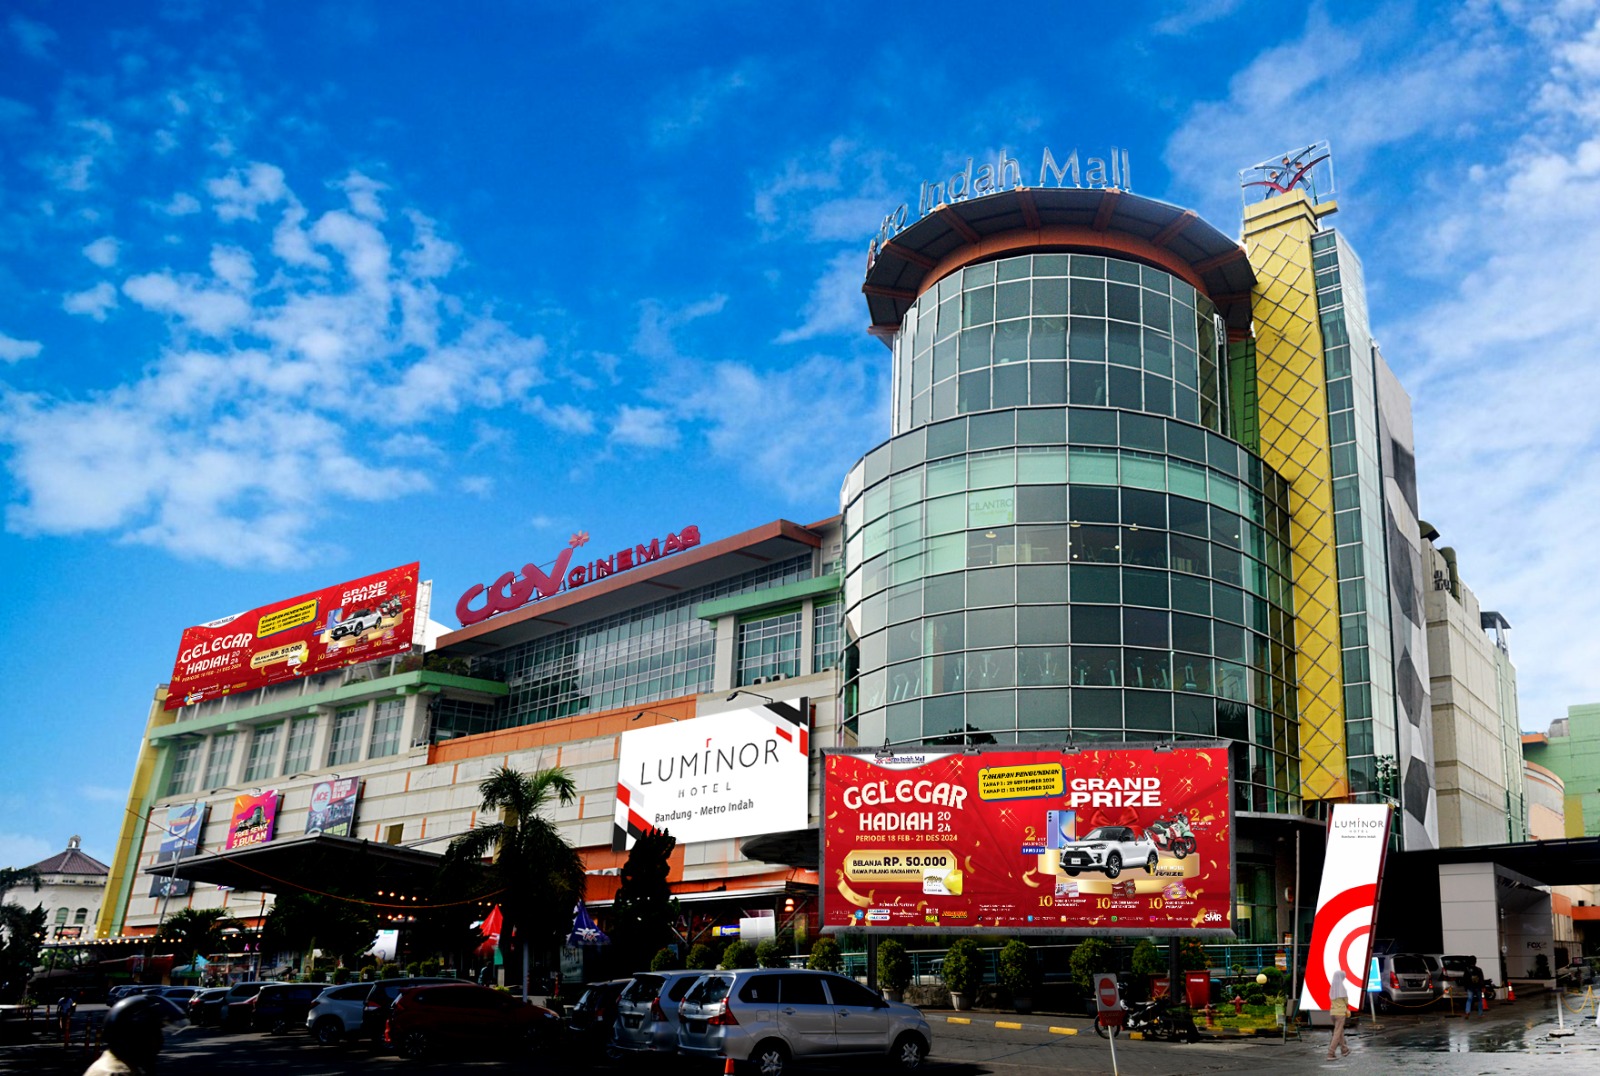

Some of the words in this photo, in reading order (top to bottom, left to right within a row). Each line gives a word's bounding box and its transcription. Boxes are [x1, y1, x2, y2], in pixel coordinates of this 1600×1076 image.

[919, 148, 1022, 217] Indah
[1040, 146, 1132, 191] Mall
[456, 547, 573, 626] CGV
[568, 525, 701, 588] CINEMAS
[341, 587, 387, 607] PRIZE
[342, 580, 388, 598] GRAND
[180, 633, 252, 664] GELEGAR
[186, 653, 230, 676] HADIAH
[677, 782, 732, 798] HOTEL
[1070, 778, 1161, 791] GRAND
[843, 780, 968, 810] GELEGAR
[1070, 791, 1162, 808] PRIZE
[654, 808, 692, 823] Bandung
[700, 803, 726, 816] Metro
[728, 799, 754, 812] Indah
[938, 811, 951, 821] 20
[1189, 808, 1200, 821] 2
[860, 812, 933, 831] HADIAH
[938, 823, 951, 832] 24
[1024, 826, 1036, 841] 2
[883, 857, 902, 866] RP.
[906, 857, 947, 866] 50.000
[1038, 895, 1053, 907] 10
[1096, 898, 1111, 909] 10
[1148, 898, 1163, 909] 10
[1526, 941, 1541, 949] FOX
